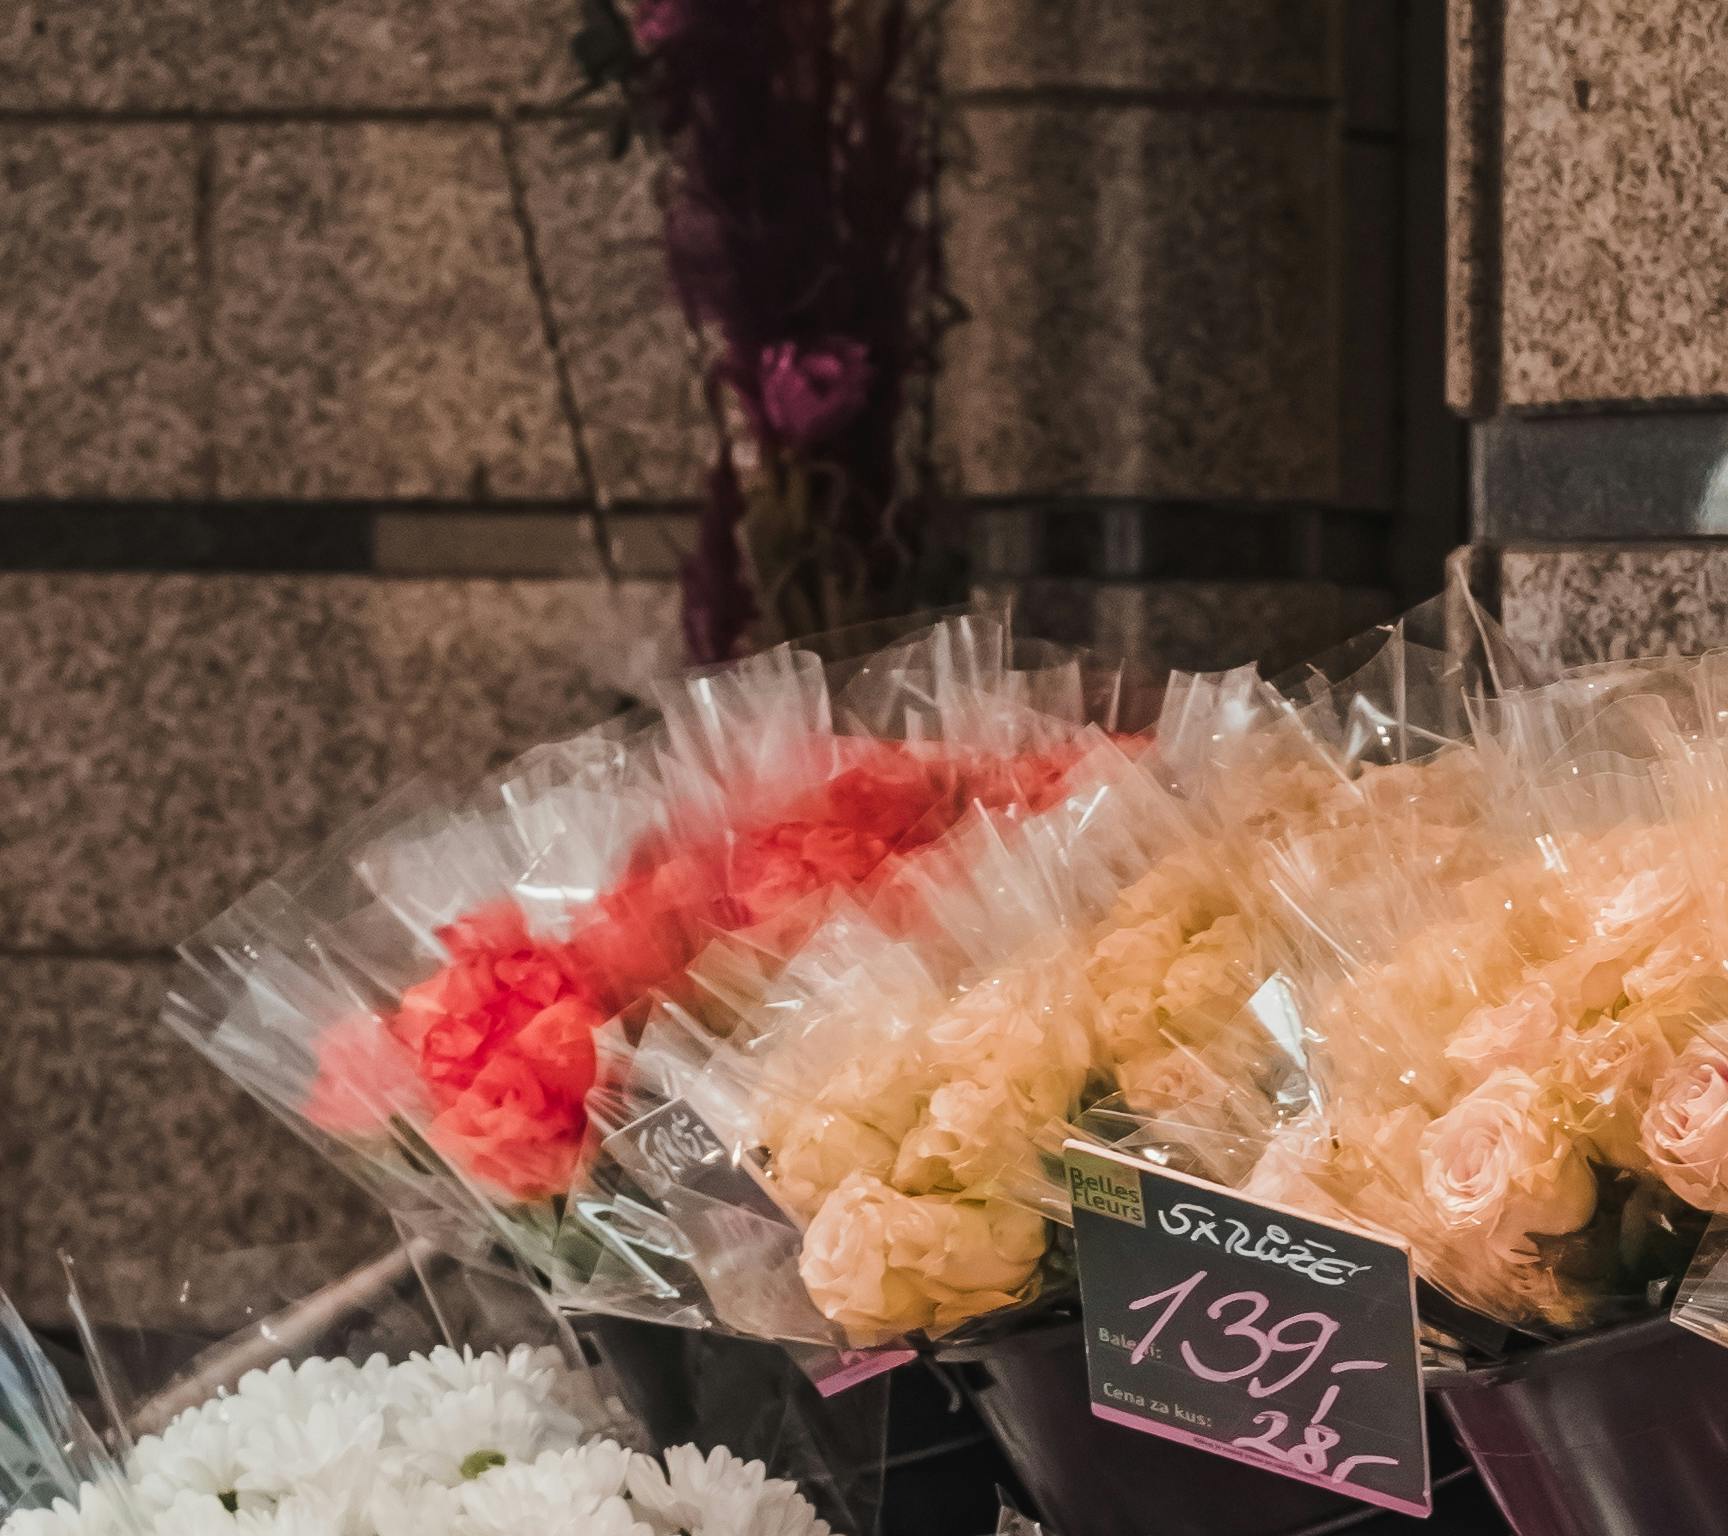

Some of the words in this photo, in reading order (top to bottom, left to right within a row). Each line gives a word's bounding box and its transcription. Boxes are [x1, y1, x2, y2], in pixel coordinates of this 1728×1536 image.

[1069, 1166, 1141, 1205] Belles
[1073, 1186, 1143, 1222] Fleurs
[1103, 1382, 1146, 1408] Cena
[1149, 1399, 1170, 1414] za
[1174, 1403, 1213, 1428] kus:
